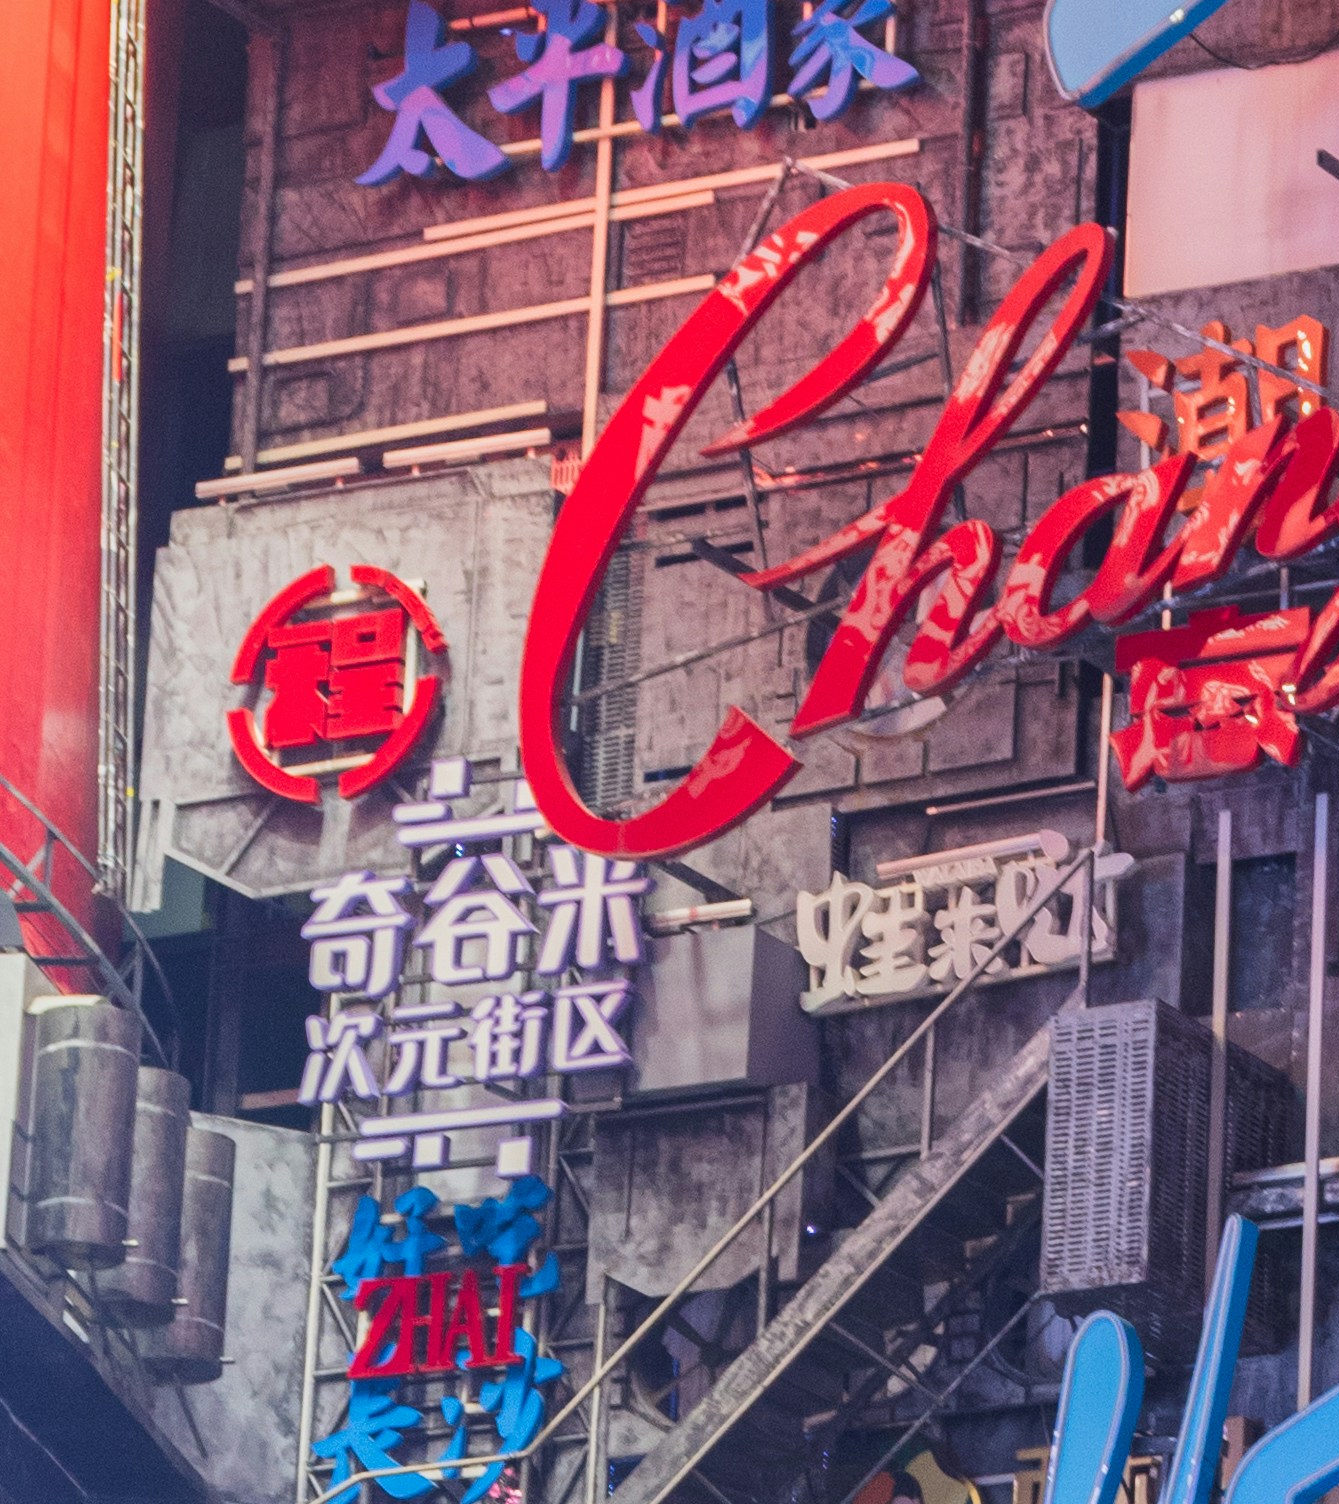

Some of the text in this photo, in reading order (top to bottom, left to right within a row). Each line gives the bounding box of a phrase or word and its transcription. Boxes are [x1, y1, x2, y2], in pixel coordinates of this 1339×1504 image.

[302, 845, 652, 998] 奇谷米
[302, 982, 634, 1103] 次元街区
[348, 1264, 529, 1380] ZHAI
